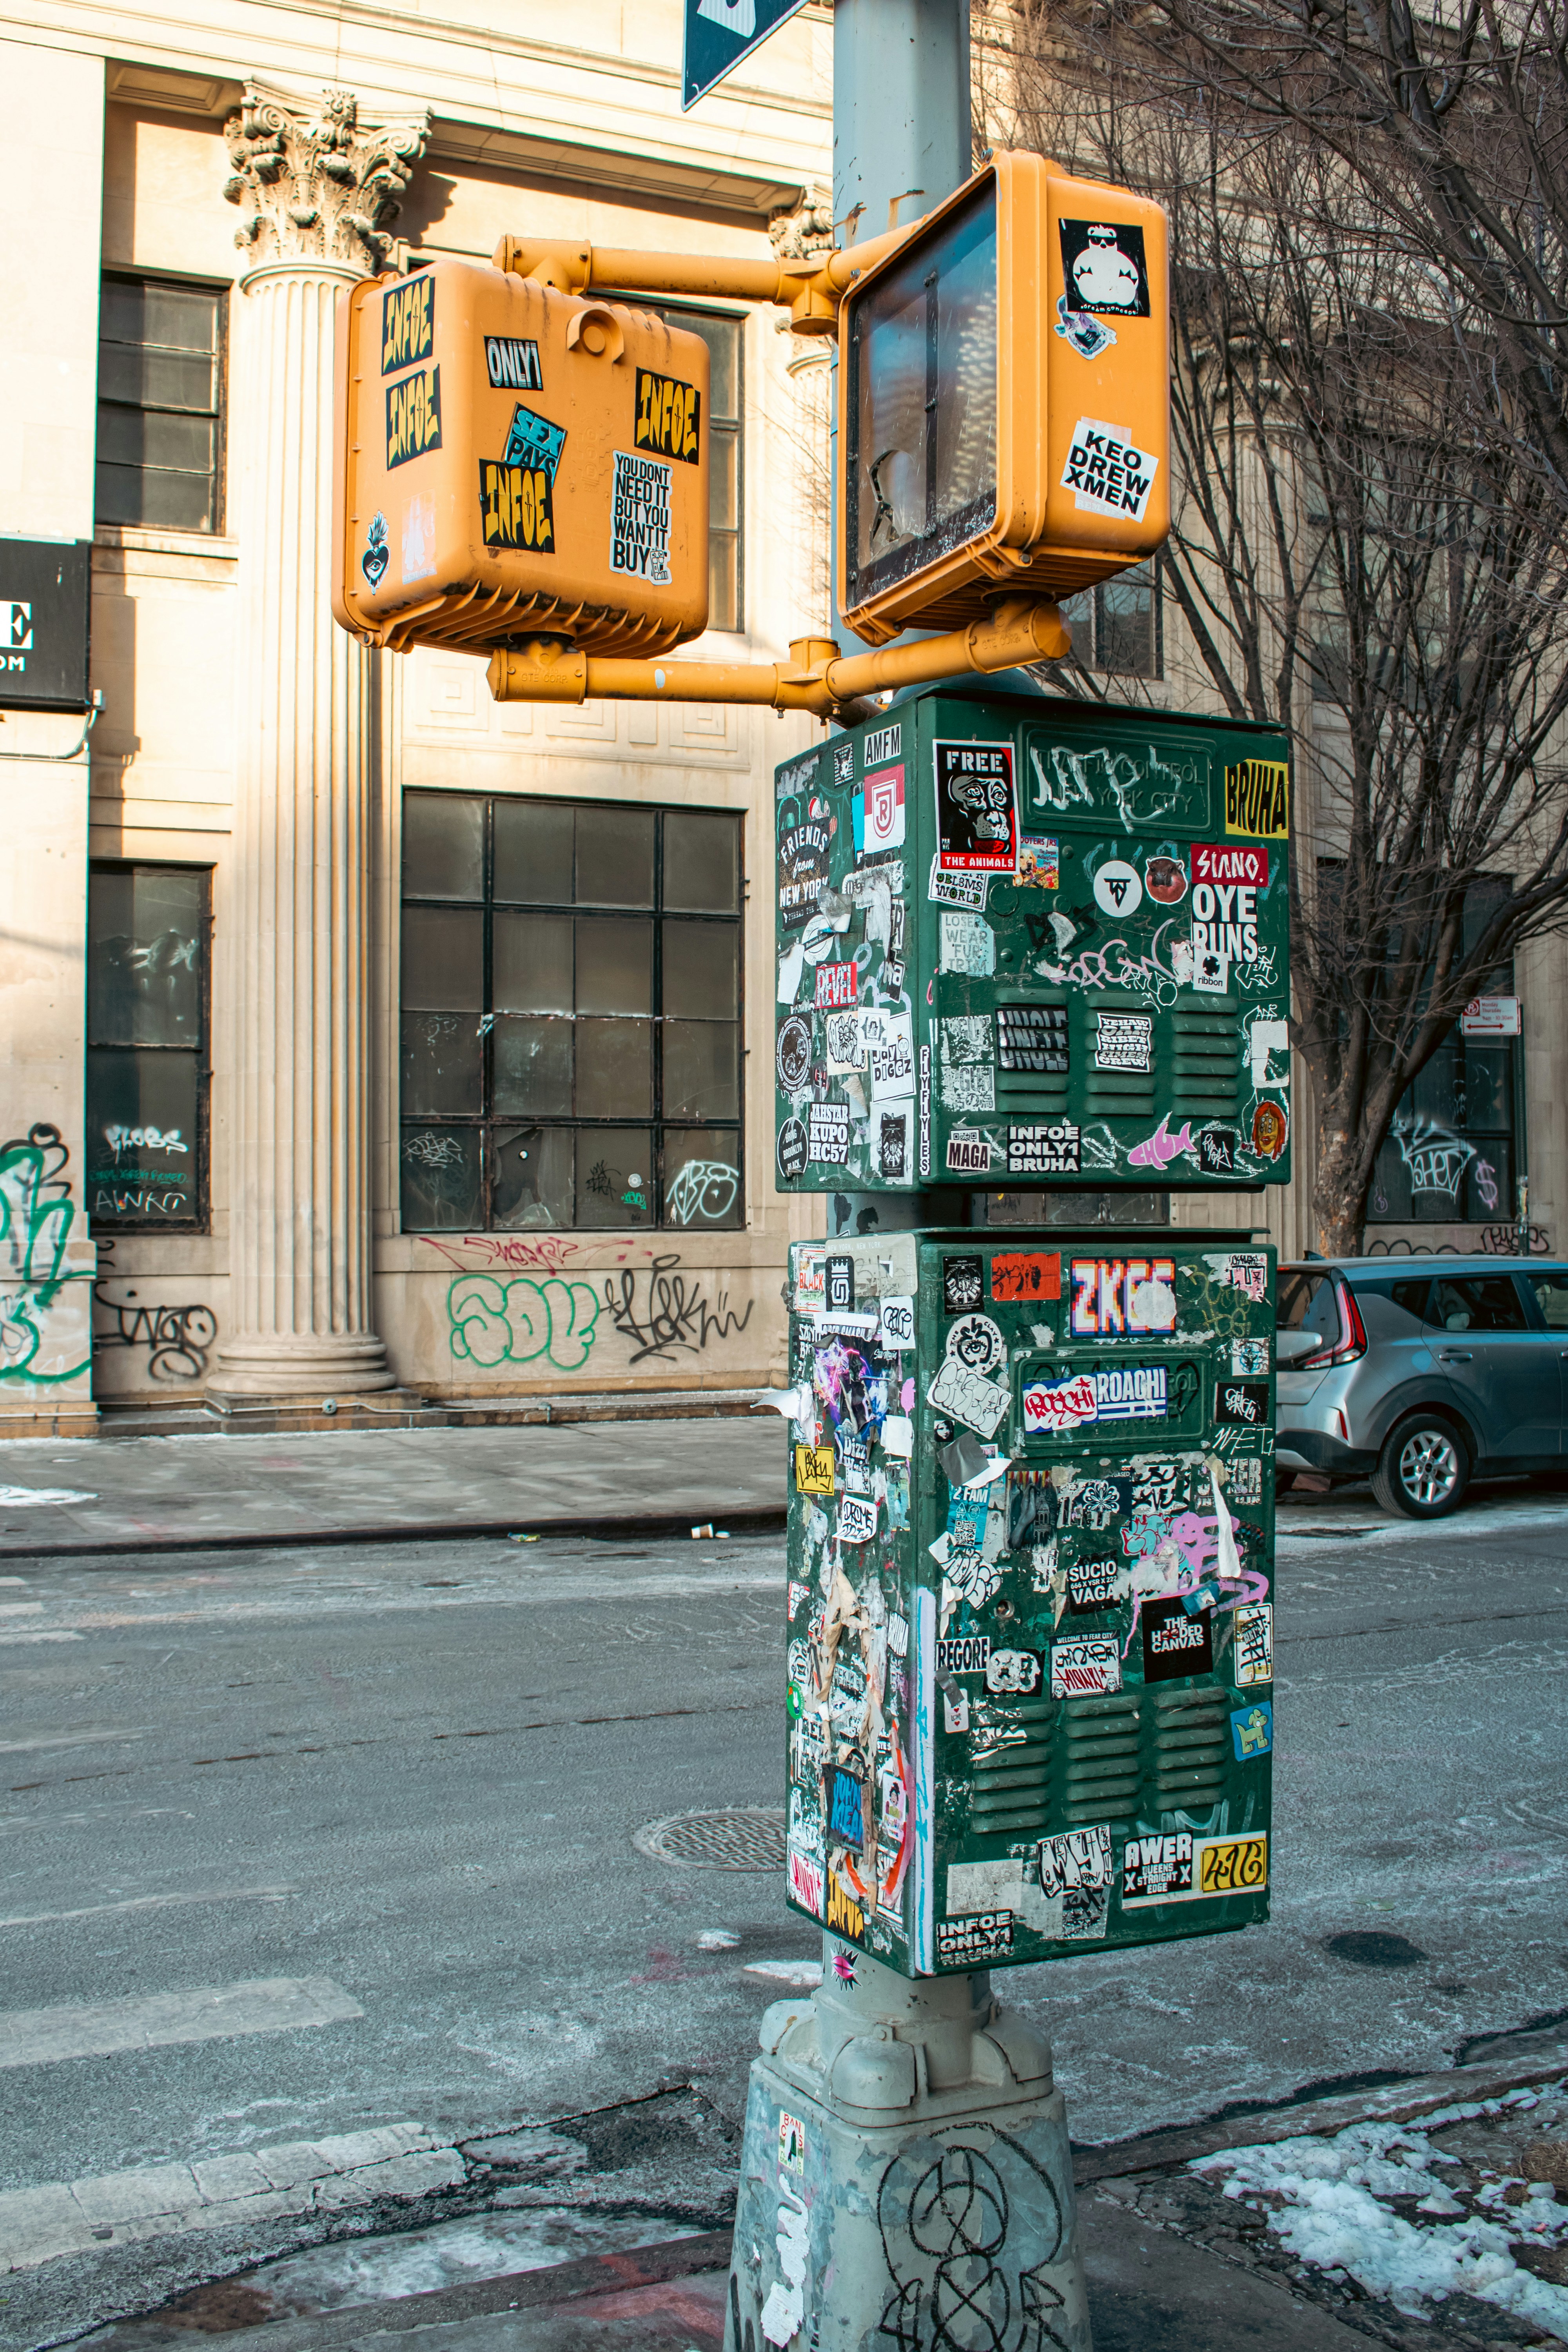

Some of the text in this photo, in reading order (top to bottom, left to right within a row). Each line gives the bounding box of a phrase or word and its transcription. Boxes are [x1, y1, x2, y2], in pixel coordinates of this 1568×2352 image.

[385, 278, 432, 365] INFOE
[488, 339, 542, 387] ONLY1
[388, 368, 438, 466] INFOE
[636, 373, 697, 456] INFOE
[514, 410, 564, 456] SEX
[1085, 430, 1142, 470] KEO
[616, 454, 669, 485] YOU DONT
[1069, 445, 1150, 497] DREW
[616, 472, 669, 508] NEED IT
[1064, 466, 1140, 515] XMEN
[485, 464, 551, 546] INFOE
[615, 496, 668, 528] BUT YOU
[614, 516, 668, 550] WANT IT
[613, 539, 650, 574] BUY
[866, 726, 900, 765] AMFM
[947, 751, 1003, 771] FREE
[1227, 760, 1287, 835] BRUHA
[780, 826, 828, 864] FRIENDS
[793, 857, 815, 878] from
[945, 857, 1014, 867] THE ANIMALS
[780, 883, 800, 907] NEW
[936, 884, 980, 904] WORLD
[1192, 884, 1257, 923] OYE
[946, 929, 987, 944] WEAR
[955, 944, 980, 958] FUR
[817, 963, 856, 1007] REVEL
[1198, 976, 1222, 987] ribbon
[1102, 1043, 1148, 1053] HIGH
[1099, 1056, 1145, 1067] CREW
[810, 1103, 848, 1124] JAHSTAR
[810, 1124, 847, 1143] KUPO
[1009, 1127, 1079, 1139] INFOE
[783, 1142, 802, 1160] BROOKLYN
[809, 1144, 847, 1162] HC57
[949, 1143, 988, 1169] MAGA
[1009, 1142, 1078, 1155] ONLY1
[1009, 1158, 1078, 1171] BRUHA
[984, 1321, 997, 1336] CLAY
[963, 1487, 988, 1503] FAM
[1069, 1561, 1116, 1582] SUCIO
[1164, 1616, 1187, 1630] THE
[1057, 1635, 1081, 1644] WELCOME
[1152, 1636, 1204, 1653] CANVAS
[1125, 1833, 1192, 1868] AWER
[1125, 1865, 1191, 1891] X STRAIGHT X
[1142, 1863, 1174, 1876] QUEENS
[1147, 1882, 1167, 1894] EDGE
[940, 1911, 1010, 1938] INFOE
[784, 2114, 801, 2133] BAN
